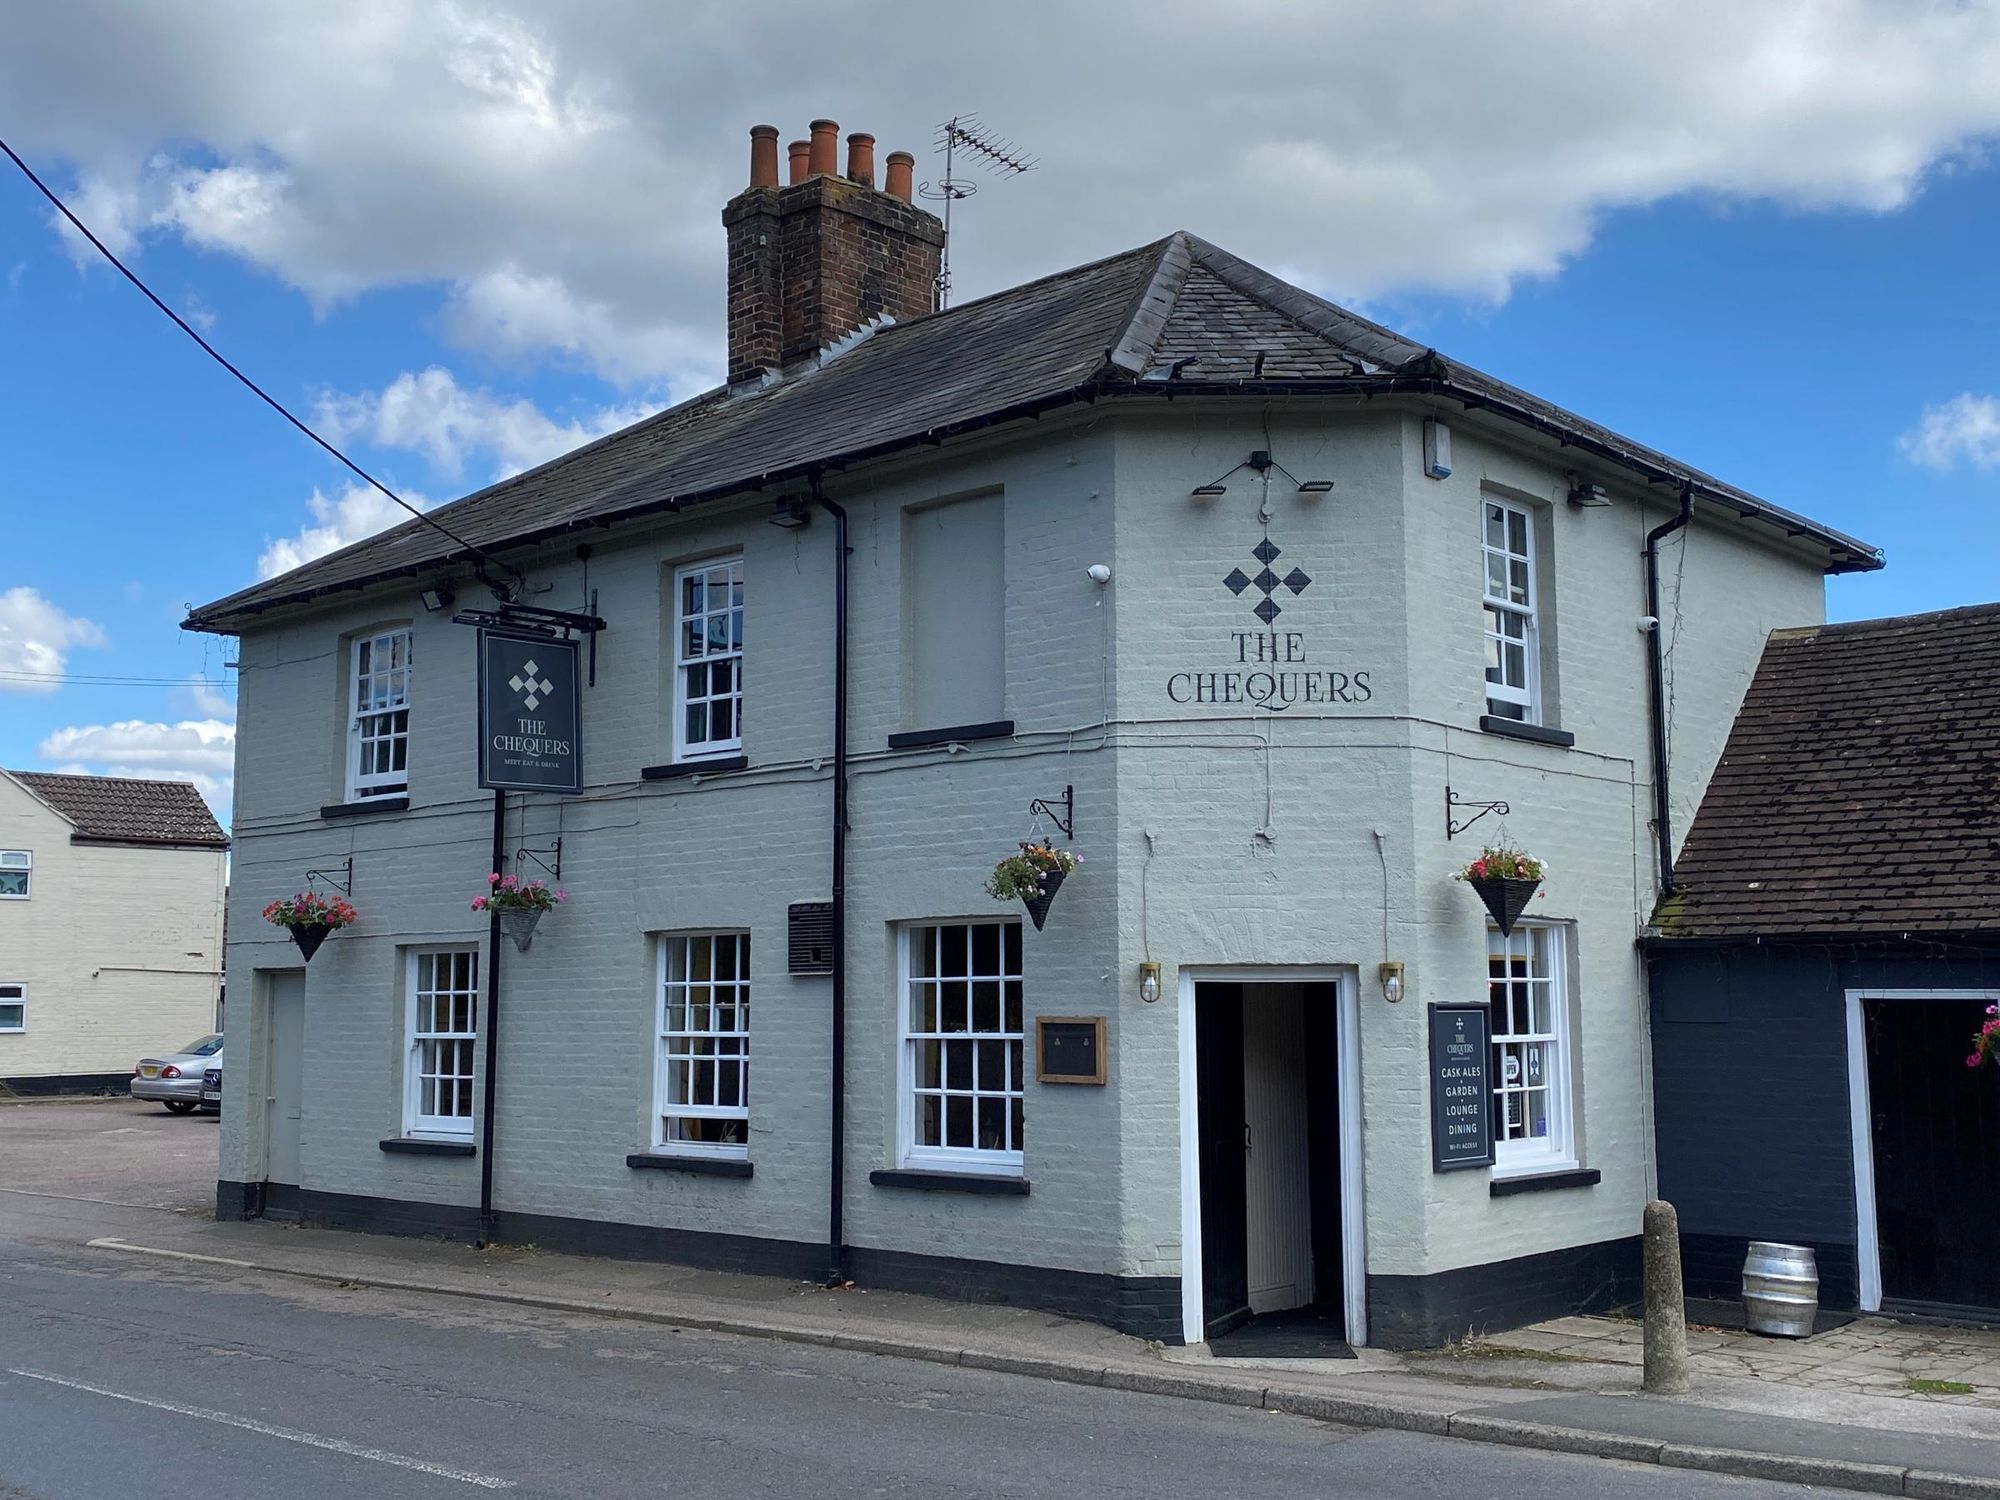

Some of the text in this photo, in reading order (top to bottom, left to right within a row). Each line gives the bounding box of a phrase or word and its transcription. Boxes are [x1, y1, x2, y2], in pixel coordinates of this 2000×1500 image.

[1231, 631, 1306, 664] THE
[1167, 671, 1372, 712] CHEQUERS
[517, 718, 547, 736] THE
[493, 735, 570, 757] CHEQUERS
[504, 758, 522, 766] MEET
[522, 759, 534, 767] EAT
[541, 761, 560, 769] DRINK
[1455, 1034, 1465, 1043] THE
[1446, 1043, 1474, 1056] CHEQUERS
[1441, 1066, 1481, 1078] CASK ALES
[1445, 1085, 1478, 1097] GARDEN
[1446, 1104, 1478, 1116] LOUNGE
[1448, 1123, 1477, 1135] DINING
